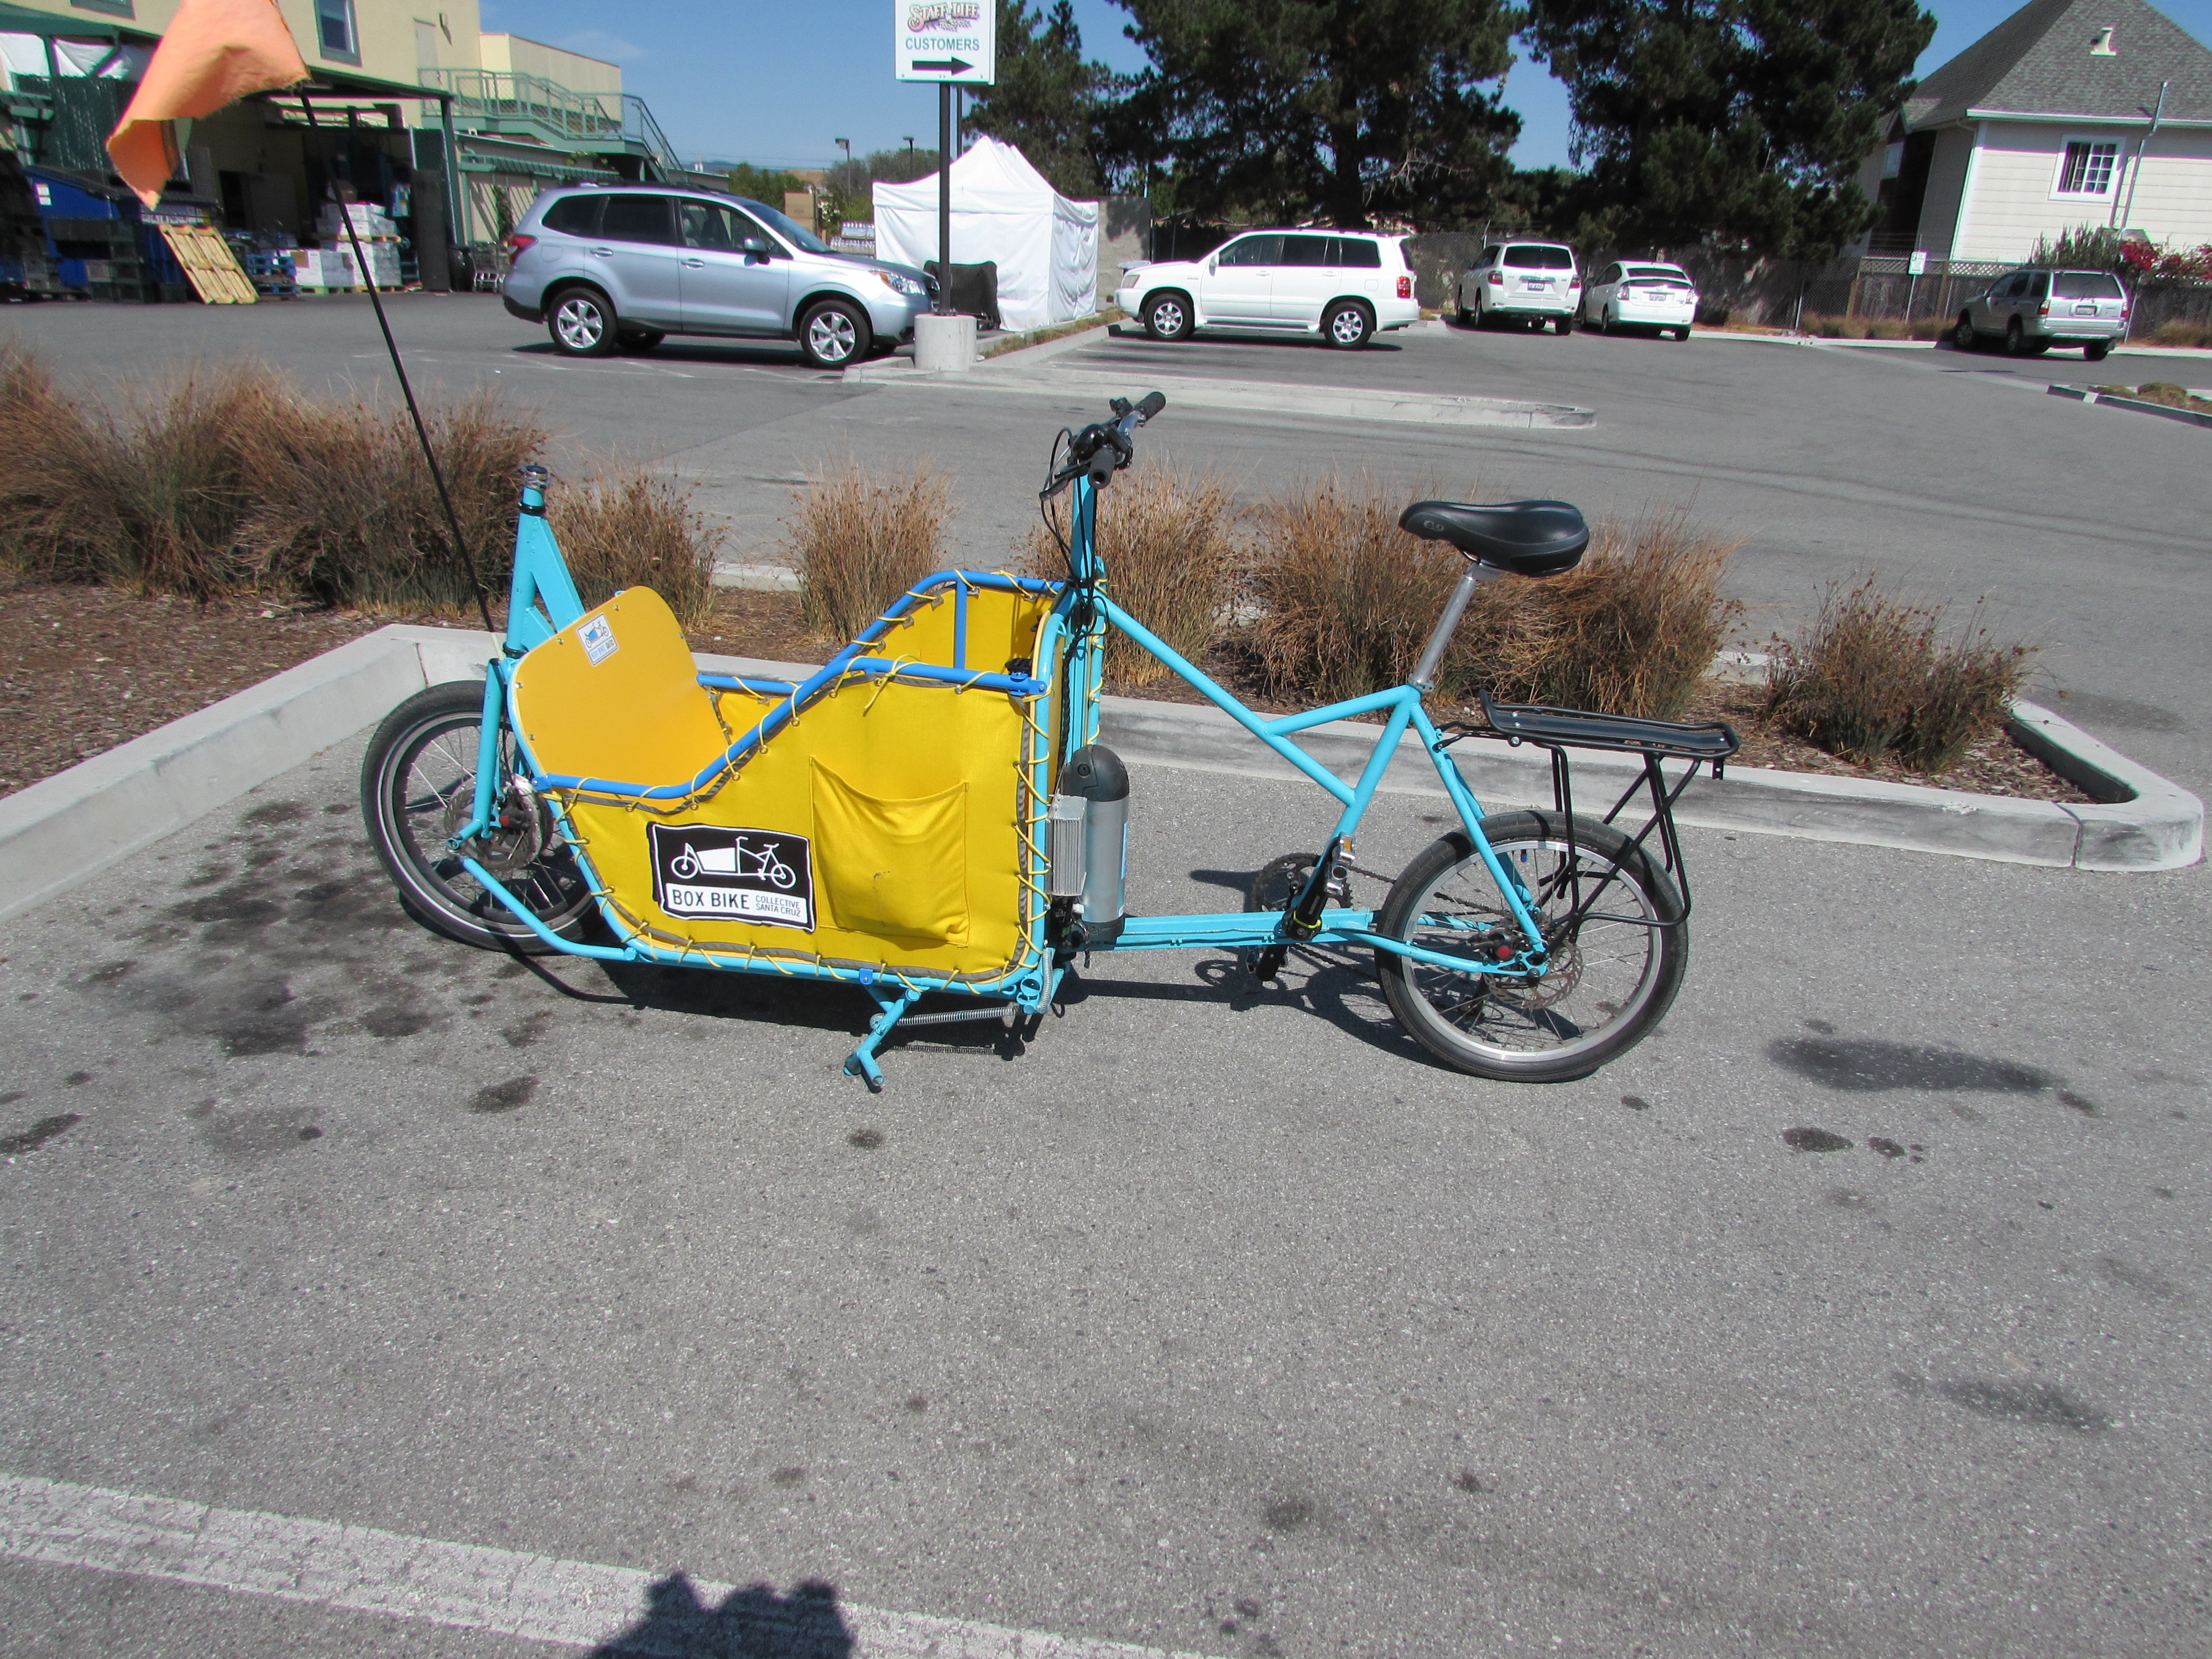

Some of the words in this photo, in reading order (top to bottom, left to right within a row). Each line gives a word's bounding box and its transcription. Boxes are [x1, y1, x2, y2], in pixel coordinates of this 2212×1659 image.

[951, 2, 980, 20] LIFE
[905, 37, 980, 51] CUSTOMERS
[672, 889, 705, 907] BOX
[711, 892, 750, 910] BIKE
[755, 895, 801, 910] COLLECTIVE
[755, 903, 779, 914] SANTA
[780, 906, 802, 918] CRUZ
